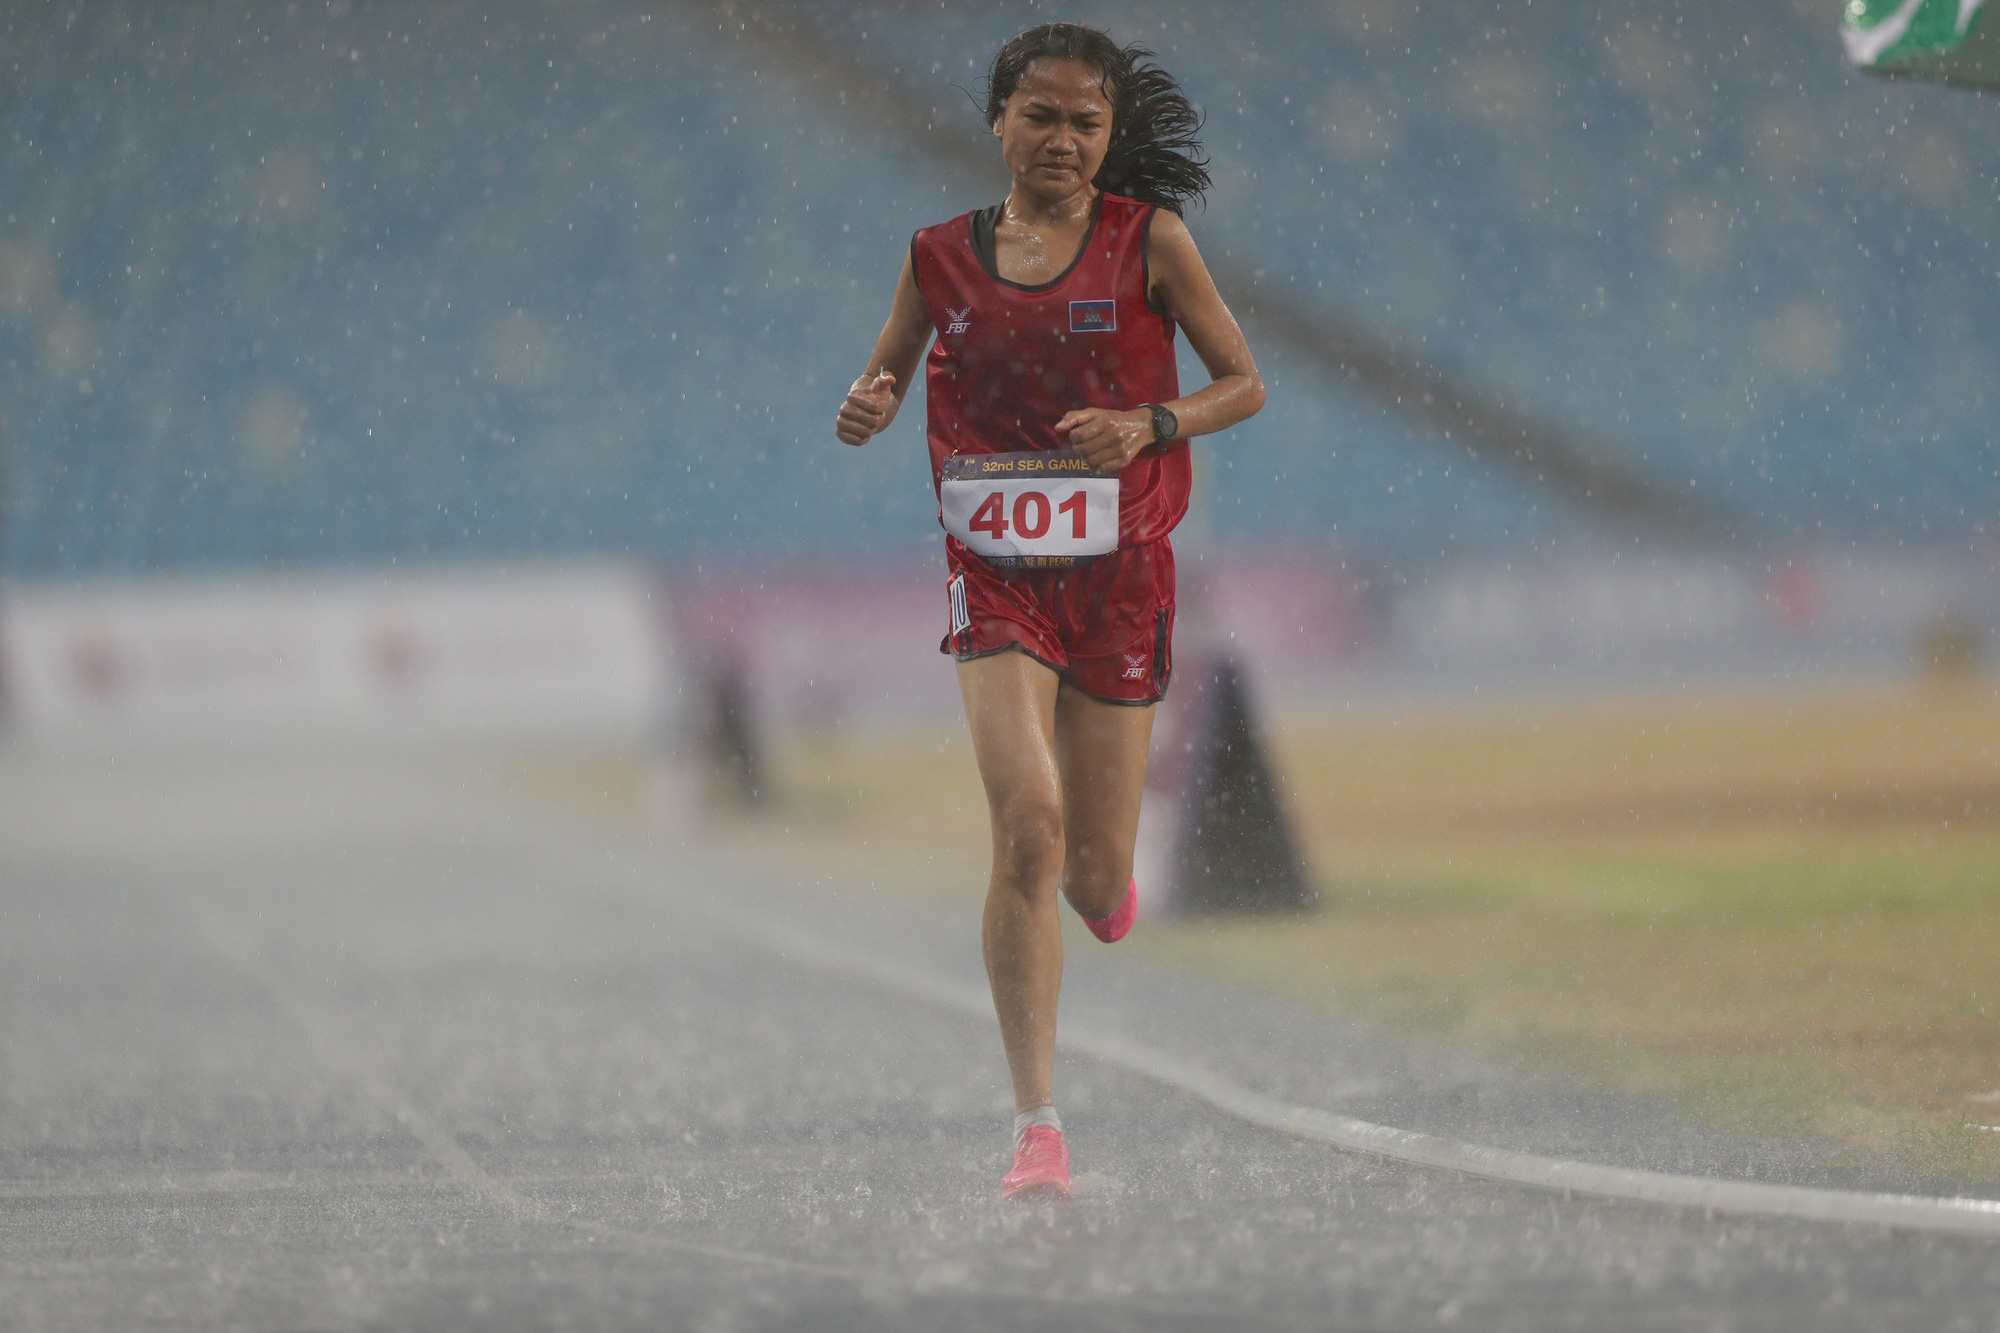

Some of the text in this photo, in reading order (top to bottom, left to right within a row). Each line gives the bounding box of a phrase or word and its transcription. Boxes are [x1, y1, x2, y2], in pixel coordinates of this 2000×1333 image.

[945, 322, 971, 334] FBT
[982, 459, 1090, 473] 32nd SEA GAME
[969, 491, 1087, 540] 401
[1037, 557, 1047, 566] IN
[1049, 557, 1075, 566] PEACE
[952, 581, 966, 631] 10
[1122, 668, 1146, 678] FBT
